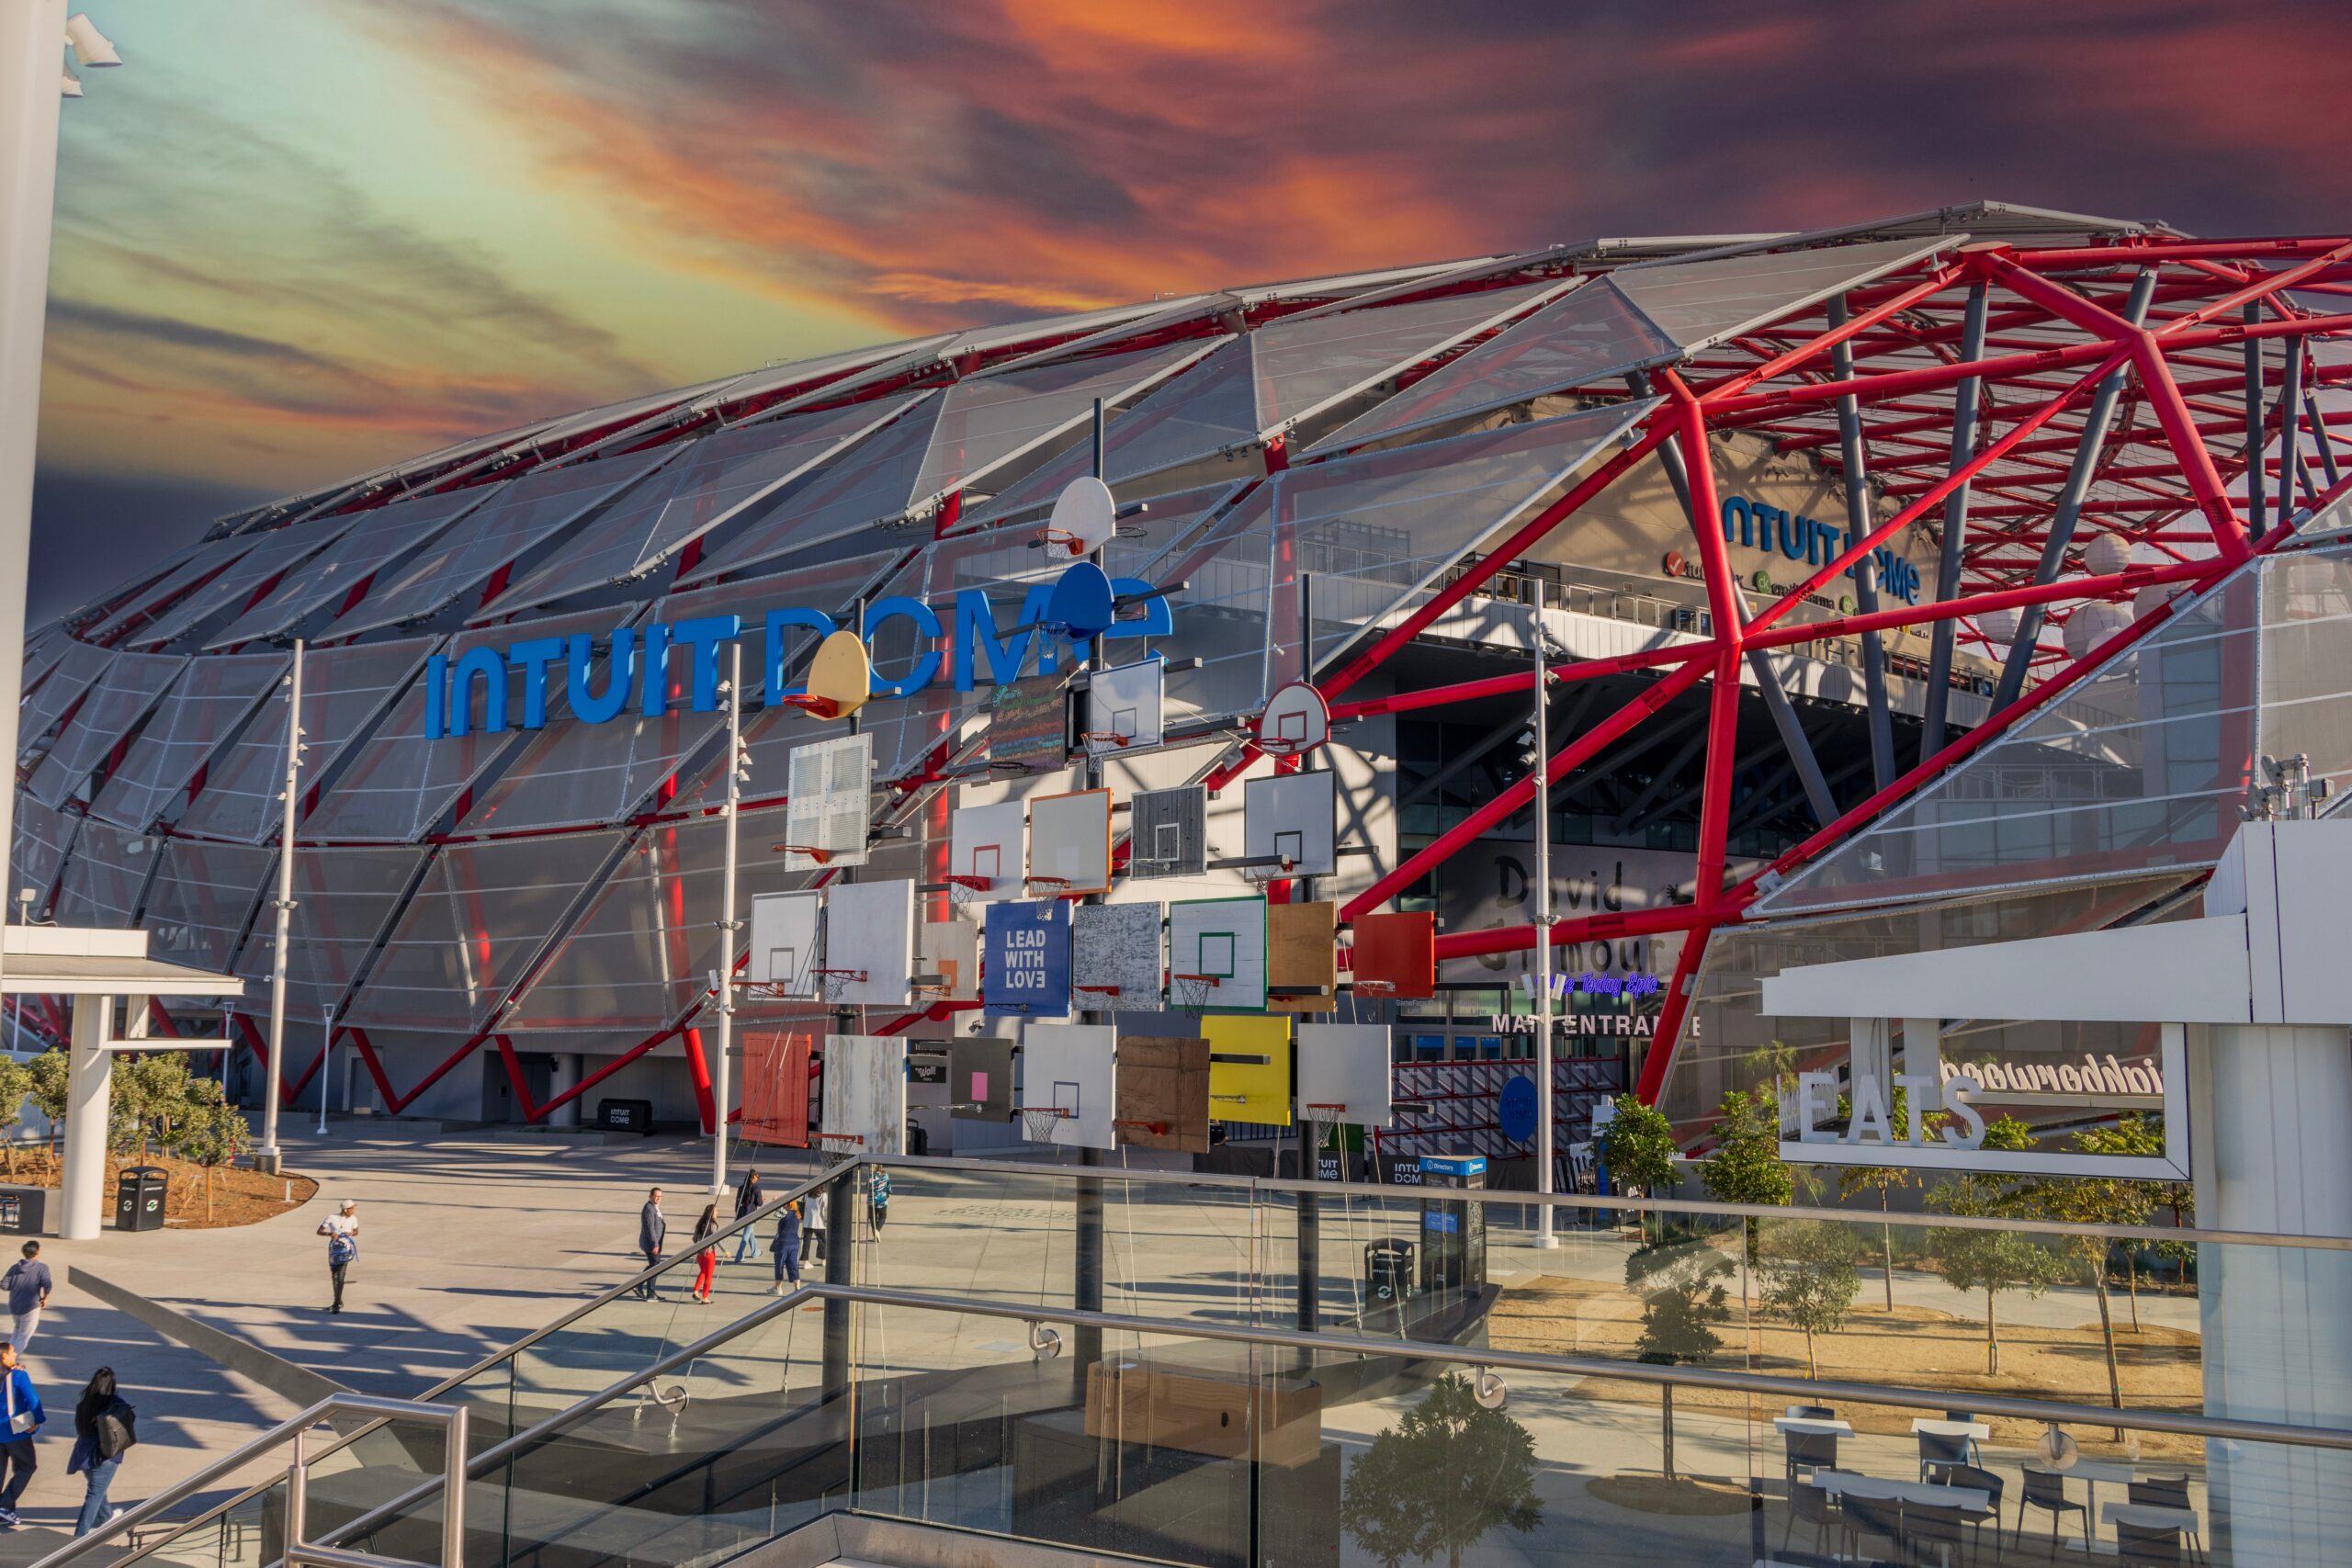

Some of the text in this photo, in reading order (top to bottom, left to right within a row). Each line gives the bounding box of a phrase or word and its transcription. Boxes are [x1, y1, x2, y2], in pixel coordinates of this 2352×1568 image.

[1721, 496, 1840, 567] NTUIT
[425, 615, 741, 739] INTUIT
[1006, 930, 1046, 948] LEAD
[1005, 950, 1045, 968] WITH
[1580, 974, 1622, 998] Today
[1626, 973, 1658, 998] Epic
[1799, 1072, 1985, 1150] EATS
[1395, 1163, 1420, 1173] INTU
[1433, 1163, 1453, 1172] Directory
[1395, 1174, 1421, 1184] DOM
